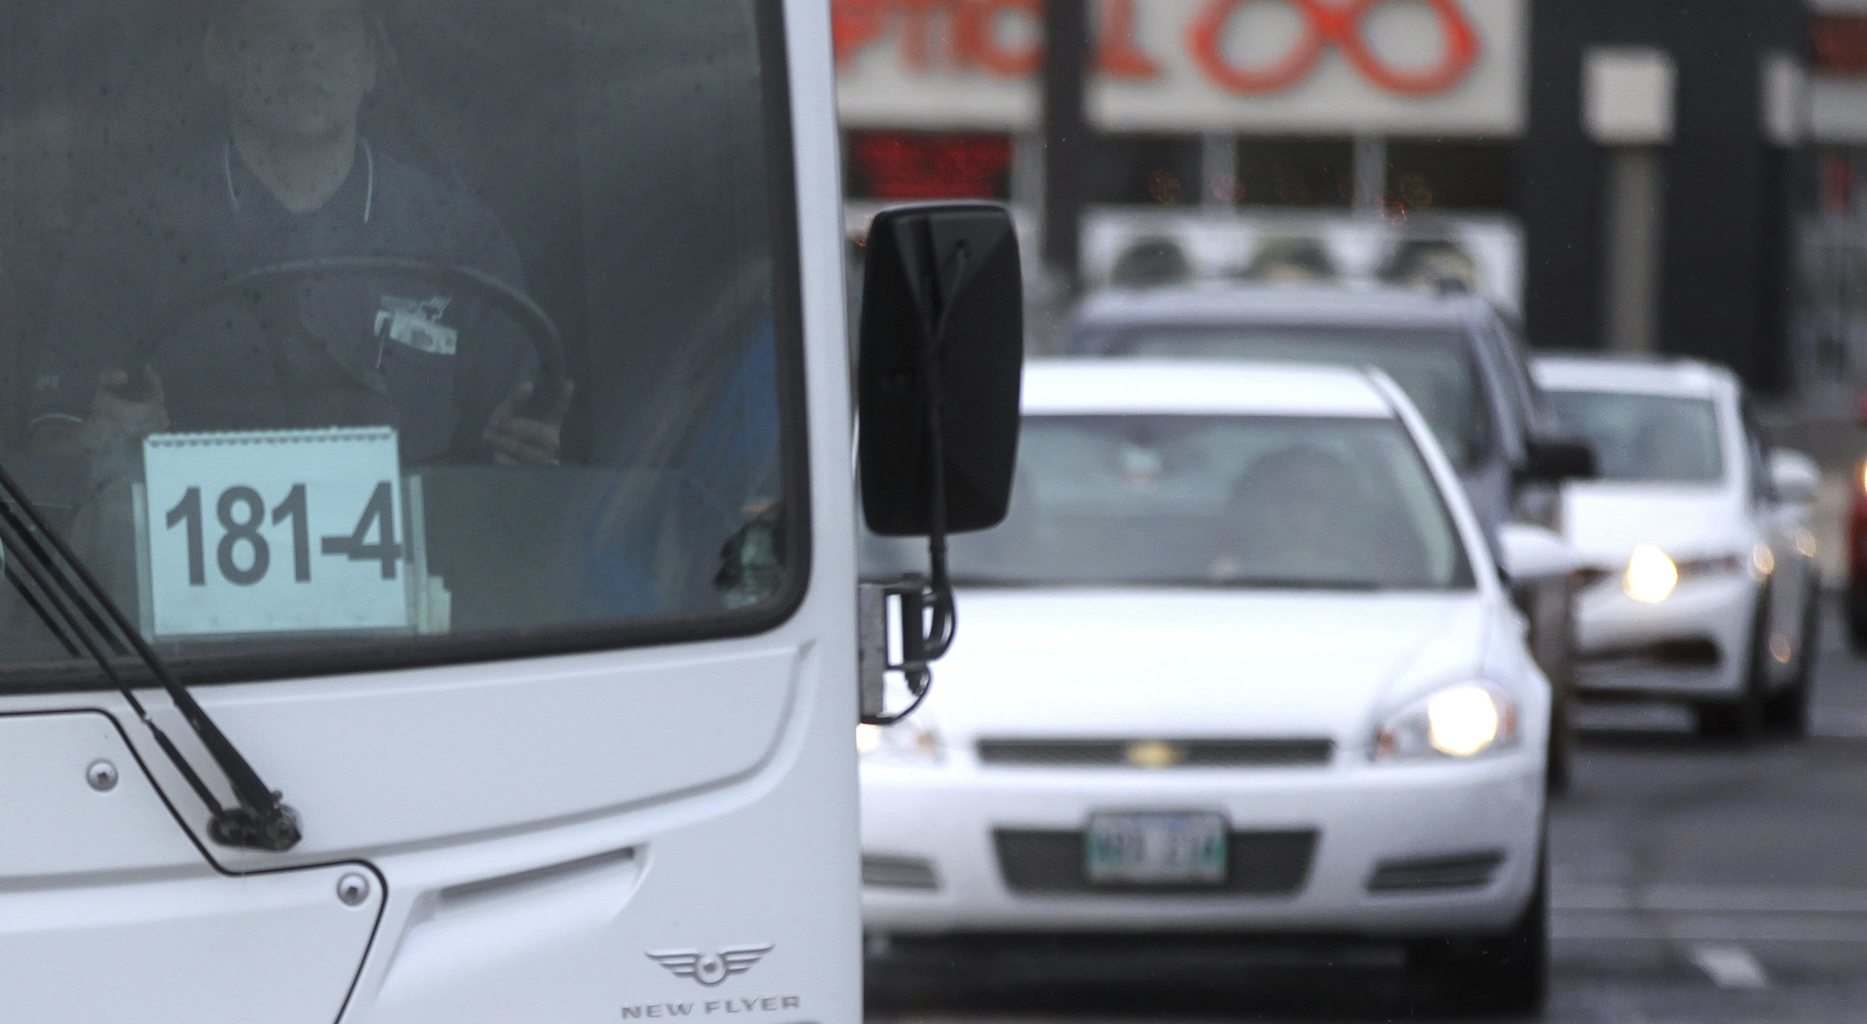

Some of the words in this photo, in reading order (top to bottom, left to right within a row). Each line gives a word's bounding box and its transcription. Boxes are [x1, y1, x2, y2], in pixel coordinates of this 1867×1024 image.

[165, 480, 404, 587] 181-4
[621, 1002, 694, 1019] NEW
[704, 996, 800, 1015] FLYER
